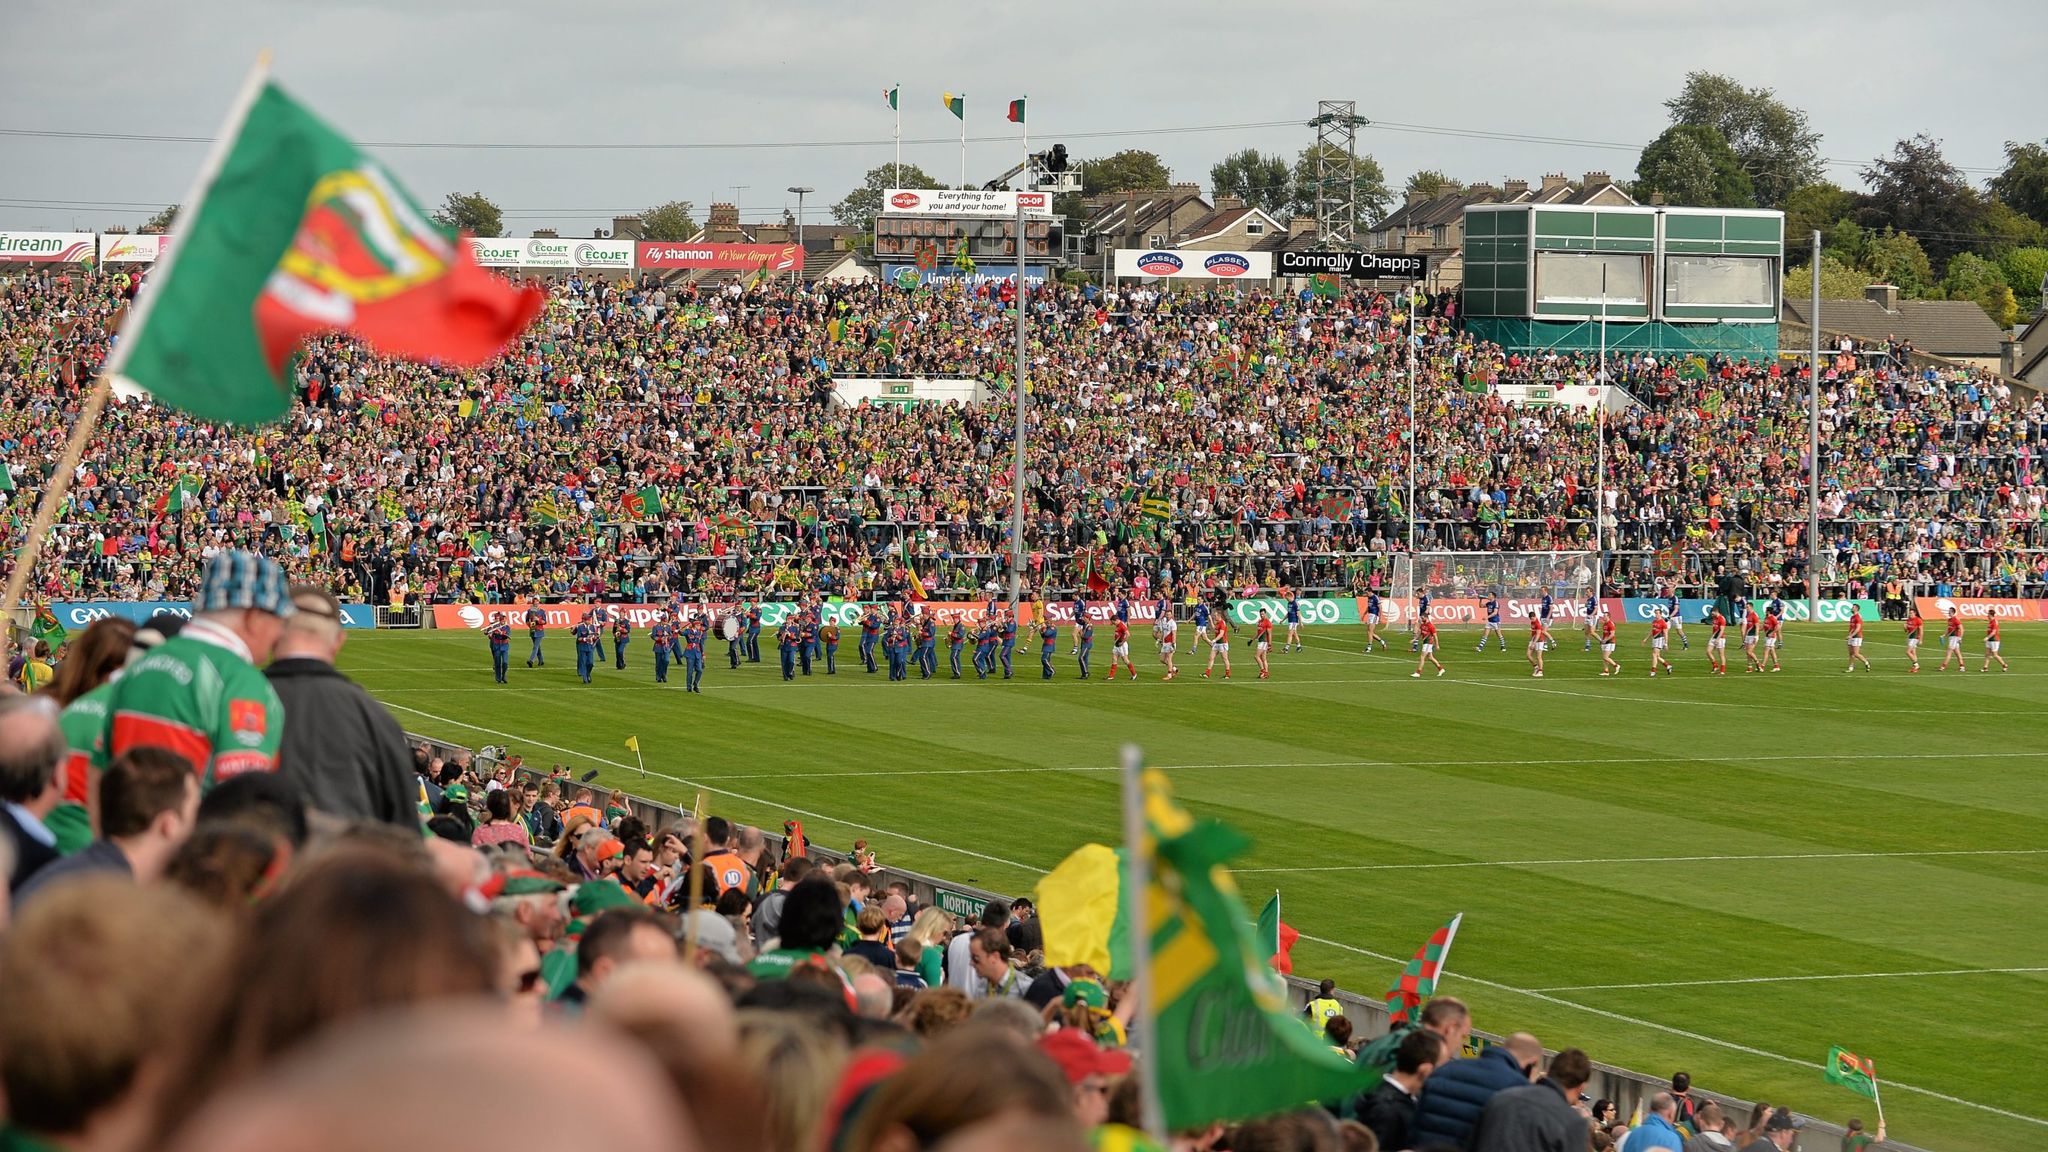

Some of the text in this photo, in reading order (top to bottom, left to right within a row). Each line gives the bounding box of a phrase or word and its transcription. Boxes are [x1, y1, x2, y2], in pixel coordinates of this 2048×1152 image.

[938, 191, 996, 201] Everything for
[1018, 197, 1043, 205] CO-OP
[928, 203, 943, 211] you
[945, 202, 960, 210] and
[476, 249, 520, 258] ECOJET
[585, 251, 629, 260] ECOJET
[645, 247, 663, 263] Fly
[665, 248, 713, 260] shannon
[1139, 255, 1182, 267] PLASSEY
[1206, 256, 1248, 267] PLASSEY
[1283, 252, 1353, 270] Connolly
[1009, 273, 1044, 285] Cntre
[1959, 603, 2025, 617] eircom
[943, 894, 973, 916] NORTH
